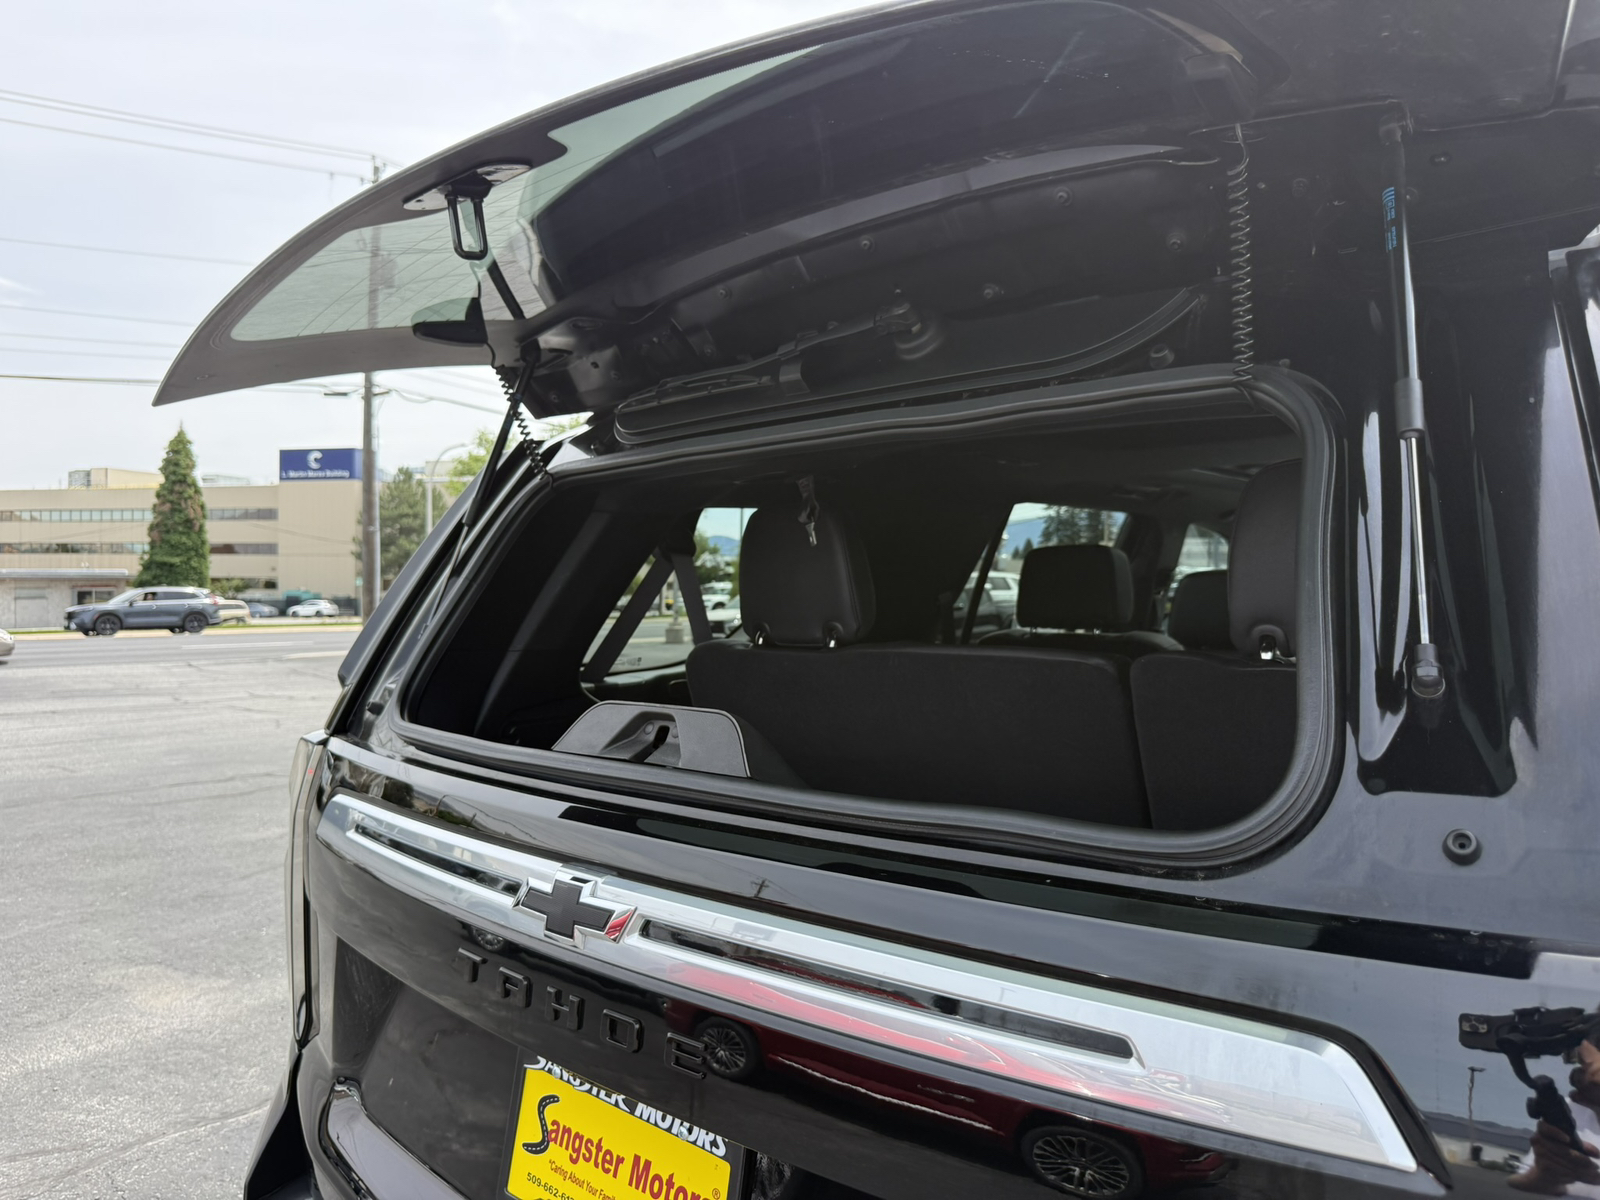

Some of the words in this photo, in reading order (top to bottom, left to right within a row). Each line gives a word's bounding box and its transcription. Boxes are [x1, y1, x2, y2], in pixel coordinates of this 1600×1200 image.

[325, 468, 350, 479] Building
[455, 947, 708, 1081] TAHOE
[521, 1094, 625, 1180] Sangster
[628, 1153, 712, 1200] Moto
[567, 1171, 586, 1189] About
[585, 1178, 599, 1198] Your
